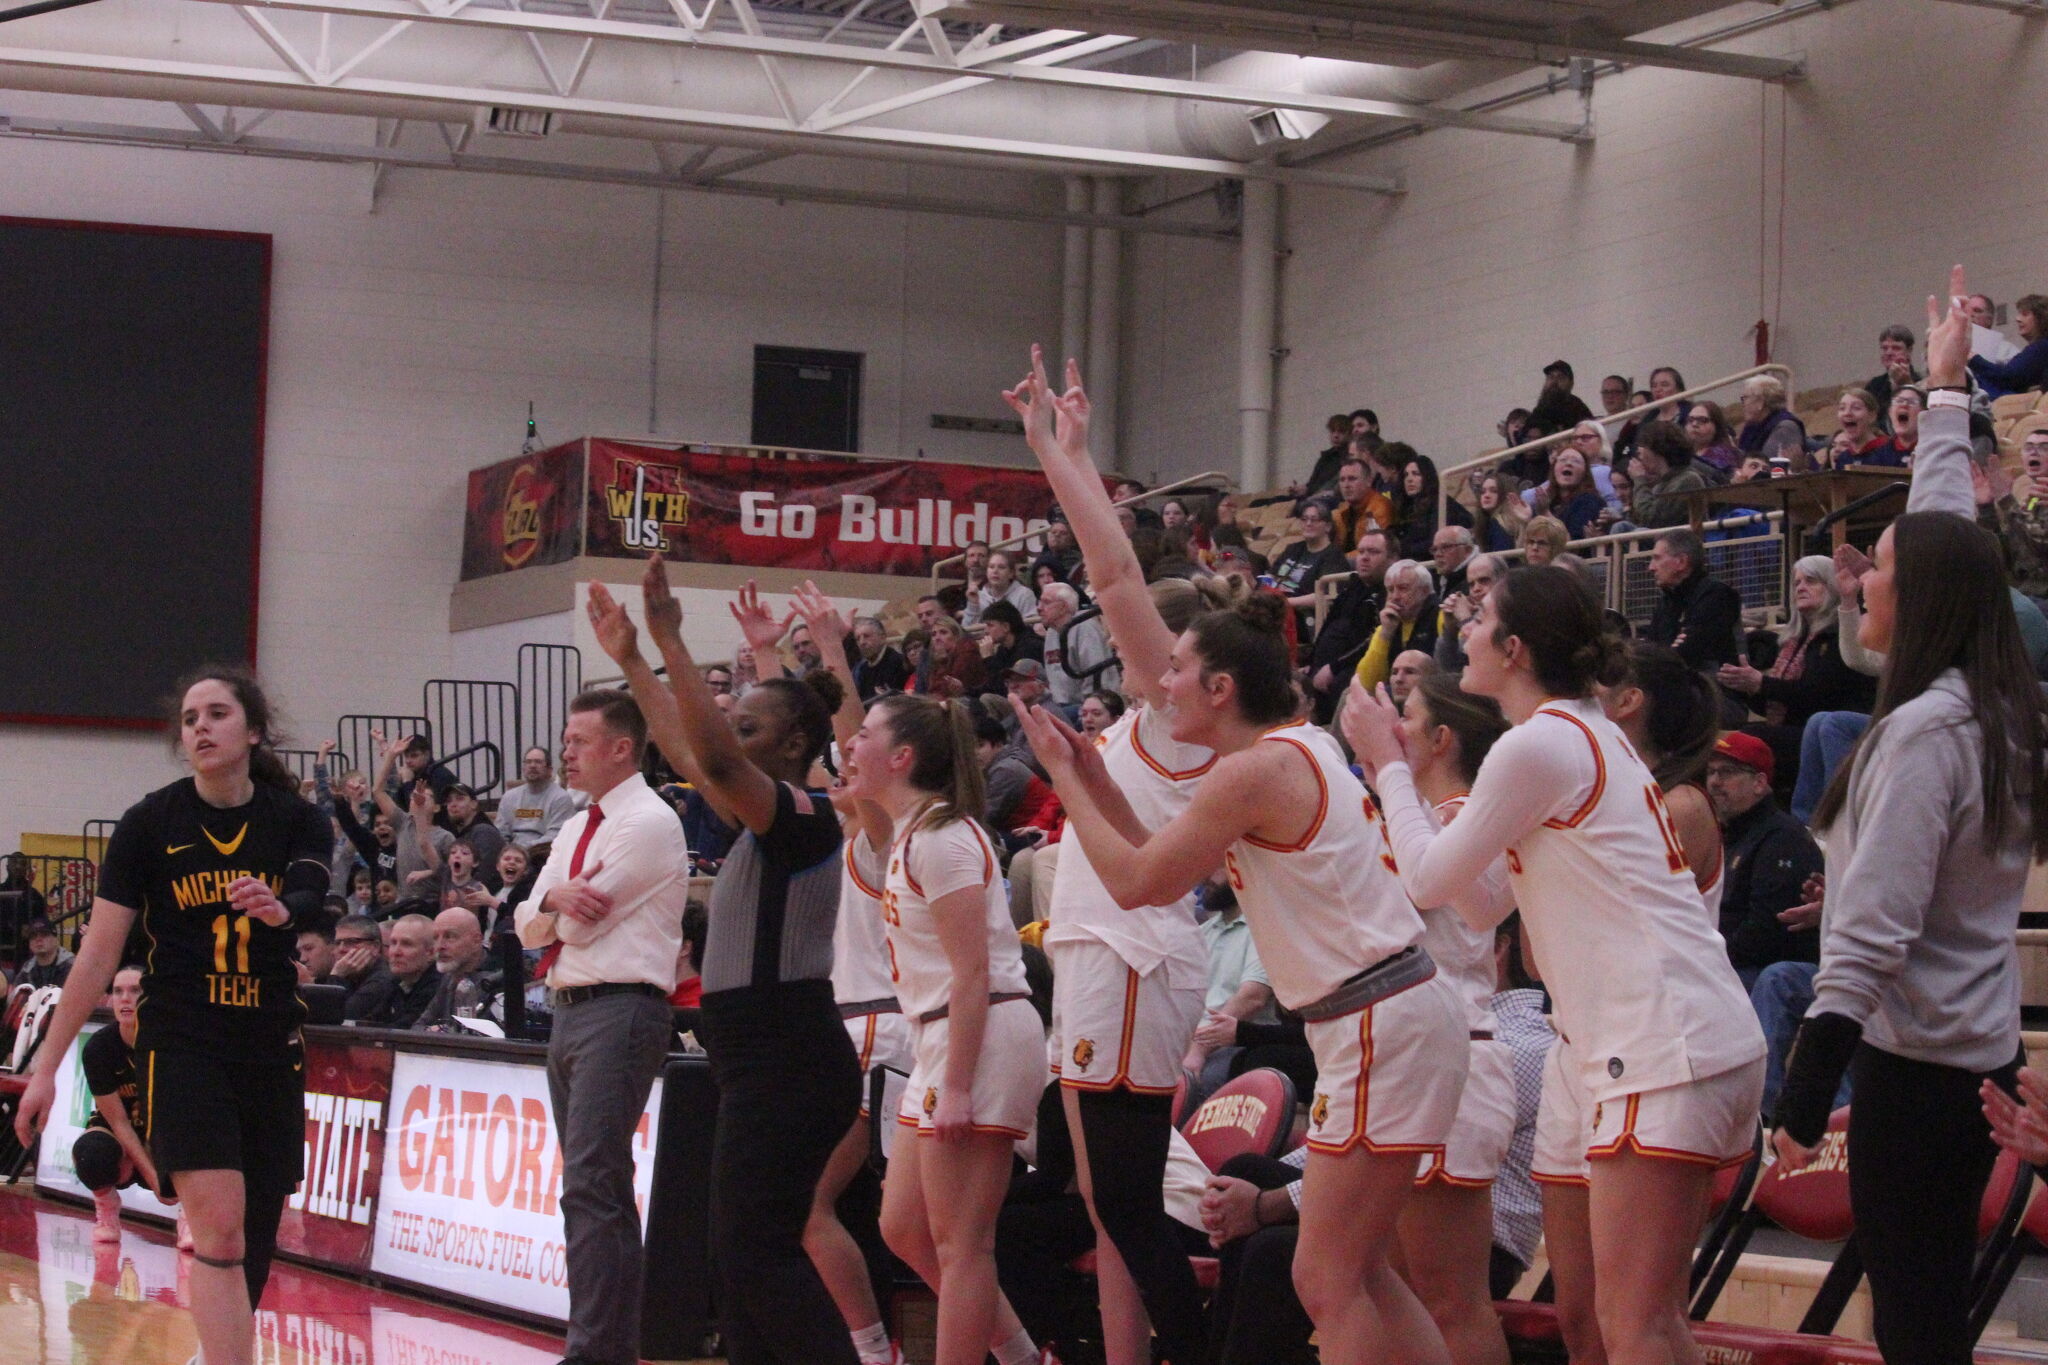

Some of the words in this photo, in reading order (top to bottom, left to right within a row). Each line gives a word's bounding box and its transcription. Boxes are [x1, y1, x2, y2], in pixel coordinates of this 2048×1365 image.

[608, 488, 685, 522] WITH
[739, 491, 817, 540] Go
[211, 914, 251, 974] 11
[205, 973, 261, 1008] TECH
[1191, 1094, 1245, 1135] FERRIS
[389, 1210, 423, 1254] THE
[423, 1217, 490, 1270] SPORTS
[488, 1230, 535, 1281] FUEL
[539, 1241, 569, 1290] CO
